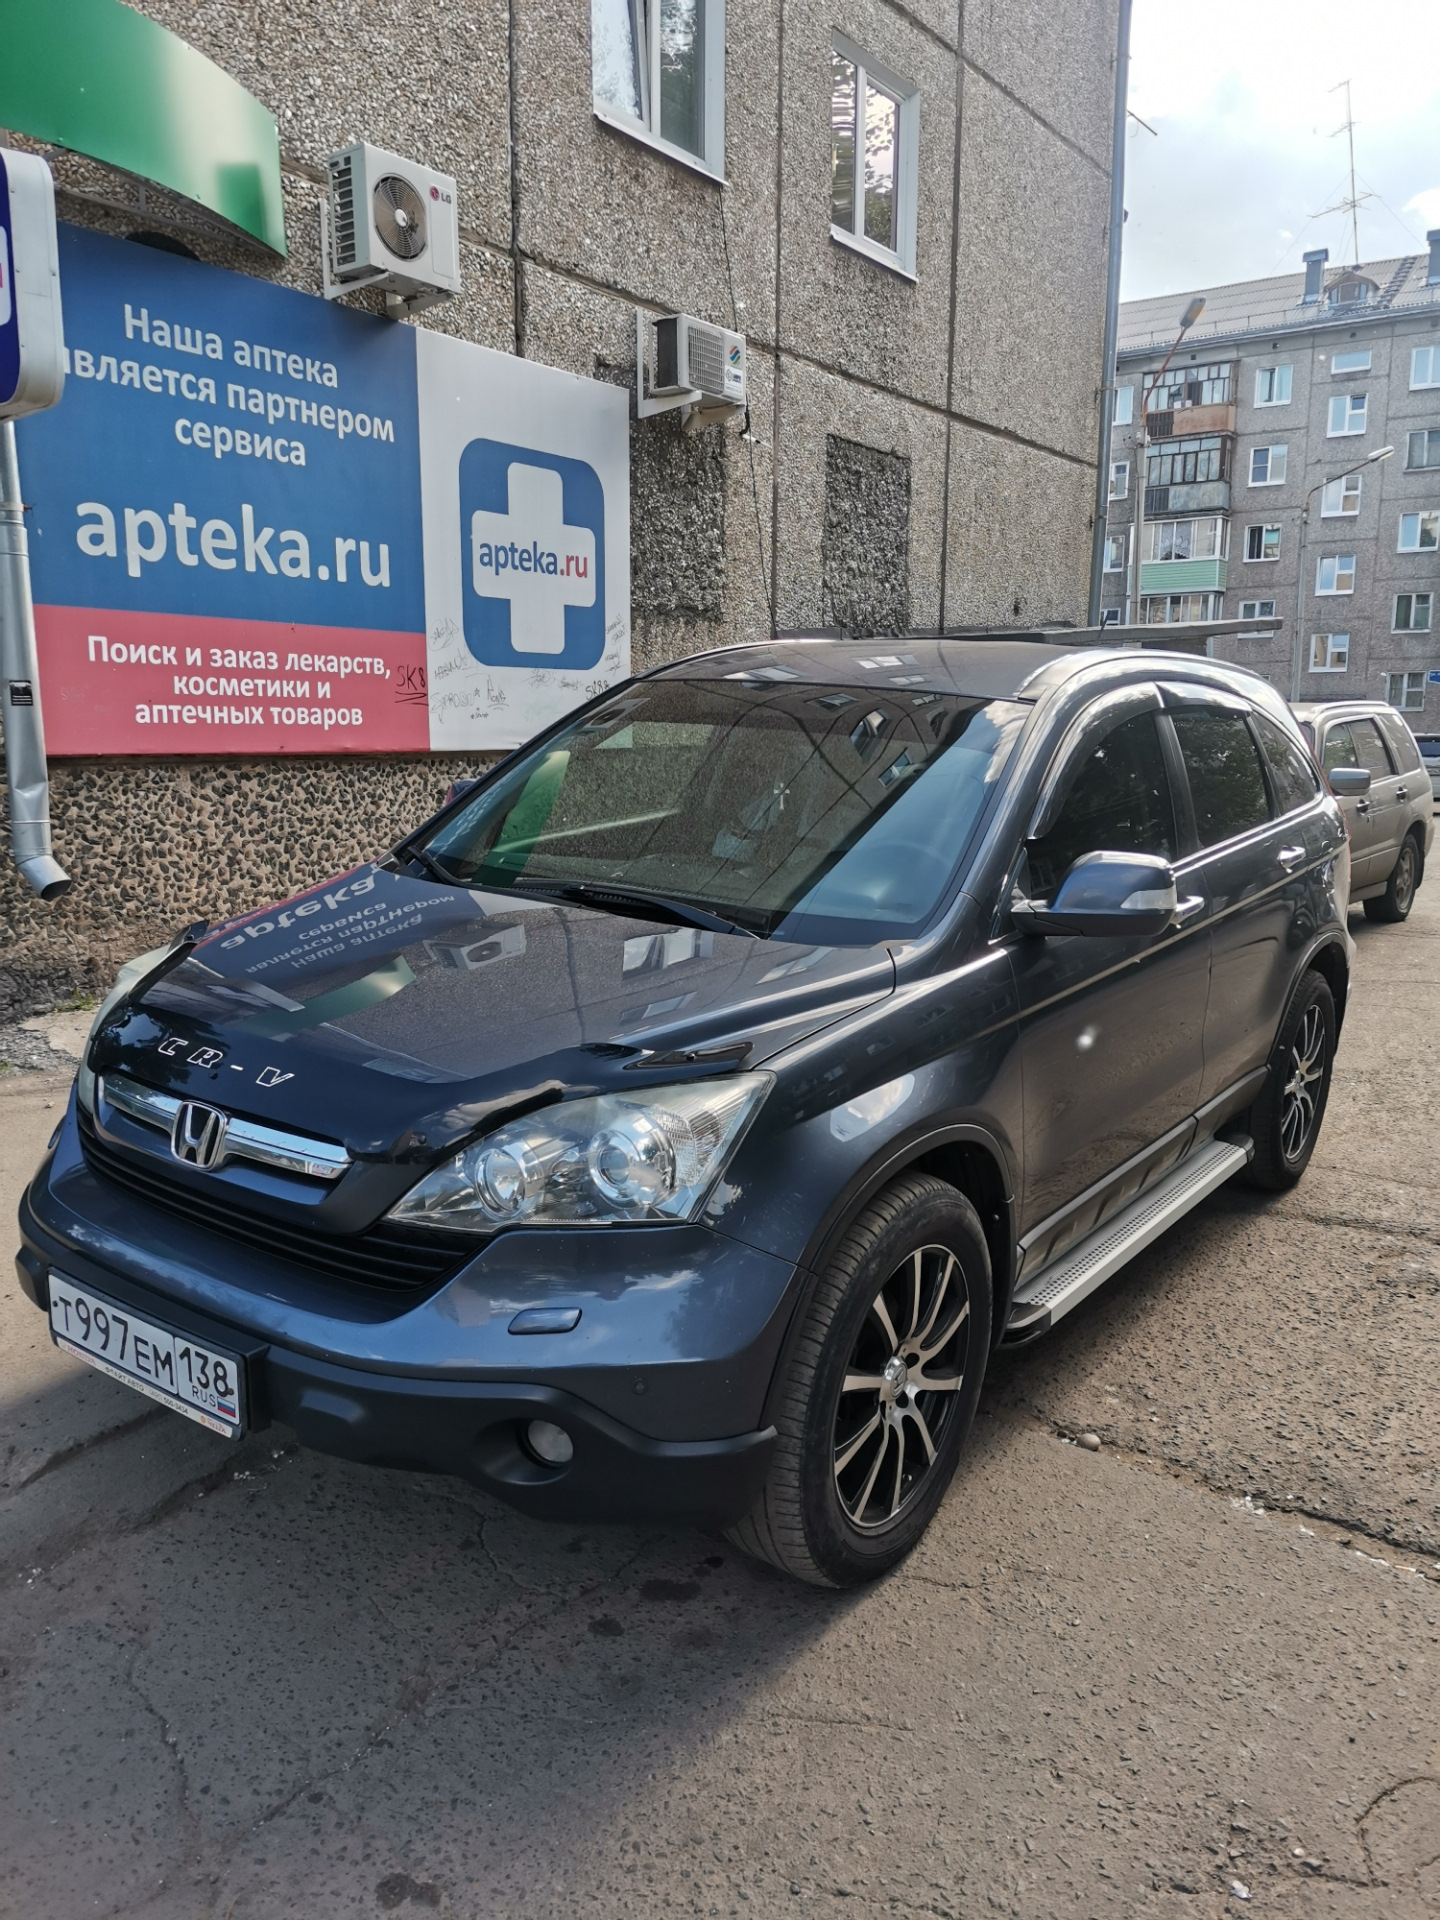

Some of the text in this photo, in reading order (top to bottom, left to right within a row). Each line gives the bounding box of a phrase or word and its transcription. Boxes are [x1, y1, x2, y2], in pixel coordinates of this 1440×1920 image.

[441, 192, 452, 205] LG
[124, 303, 338, 389] Наша аптека
[227, 382, 395, 443] партнером
[174, 417, 306, 467] сервиса
[76, 501, 391, 588] apteka.ru
[479, 540, 588, 579] apteka.ru
[88, 635, 391, 680] Поиск и заказ лекарств,
[174, 674, 331, 699] косметики и
[135, 703, 363, 731] аптечных товаров
[179, 1346, 229, 1398] 138
[192, 1384, 217, 1408] RUS
